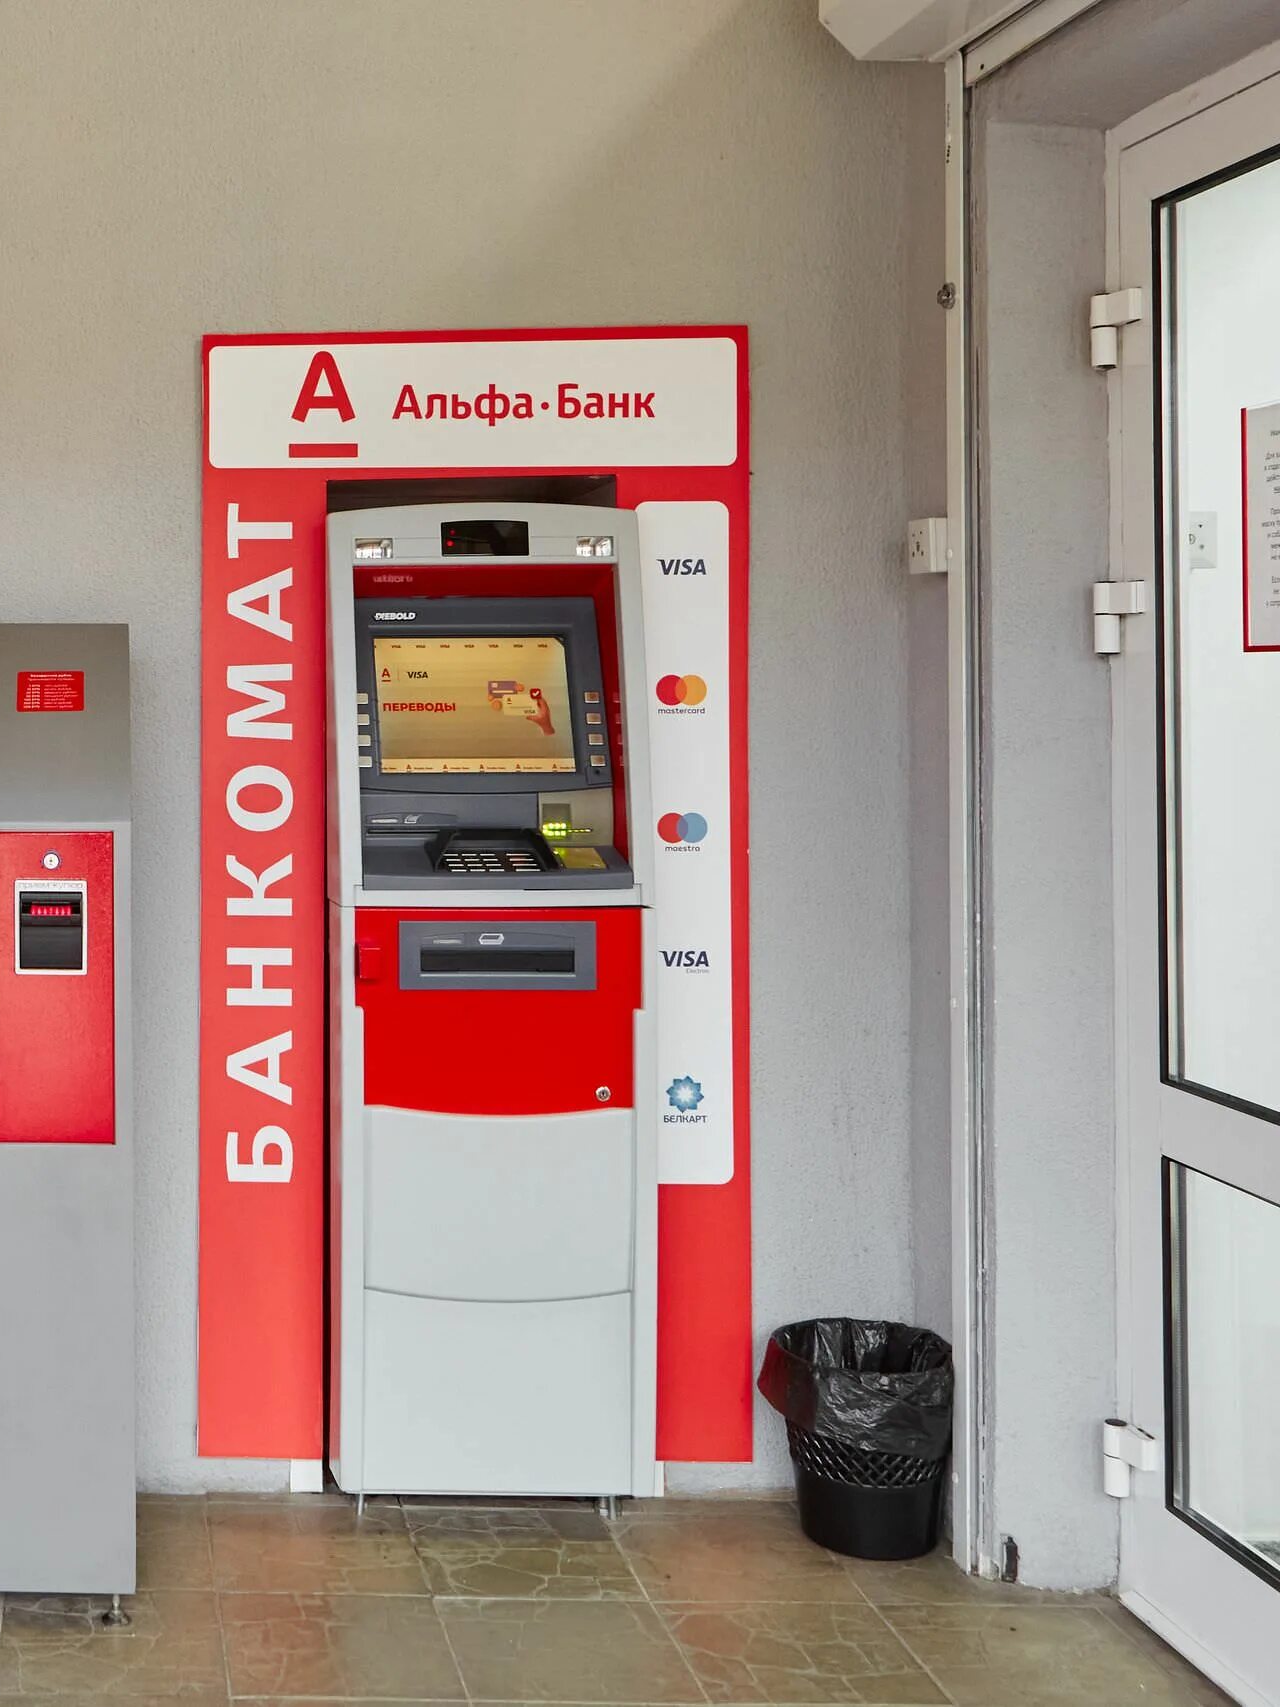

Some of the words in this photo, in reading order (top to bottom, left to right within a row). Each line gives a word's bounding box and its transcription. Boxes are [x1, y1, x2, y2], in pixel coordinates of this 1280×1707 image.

[656, 558, 707, 576] VISA
[374, 612, 416, 621] DIEBOLD
[407, 671, 429, 679] VISA
[382, 702, 456, 713] ПЕРЕВОДЫ
[657, 707, 706, 715] mastercard
[225, 502, 294, 1185] БАНКОМАТ
[658, 950, 710, 968] VISA
[663, 1114, 707, 1124] БЕЛКАРТ
